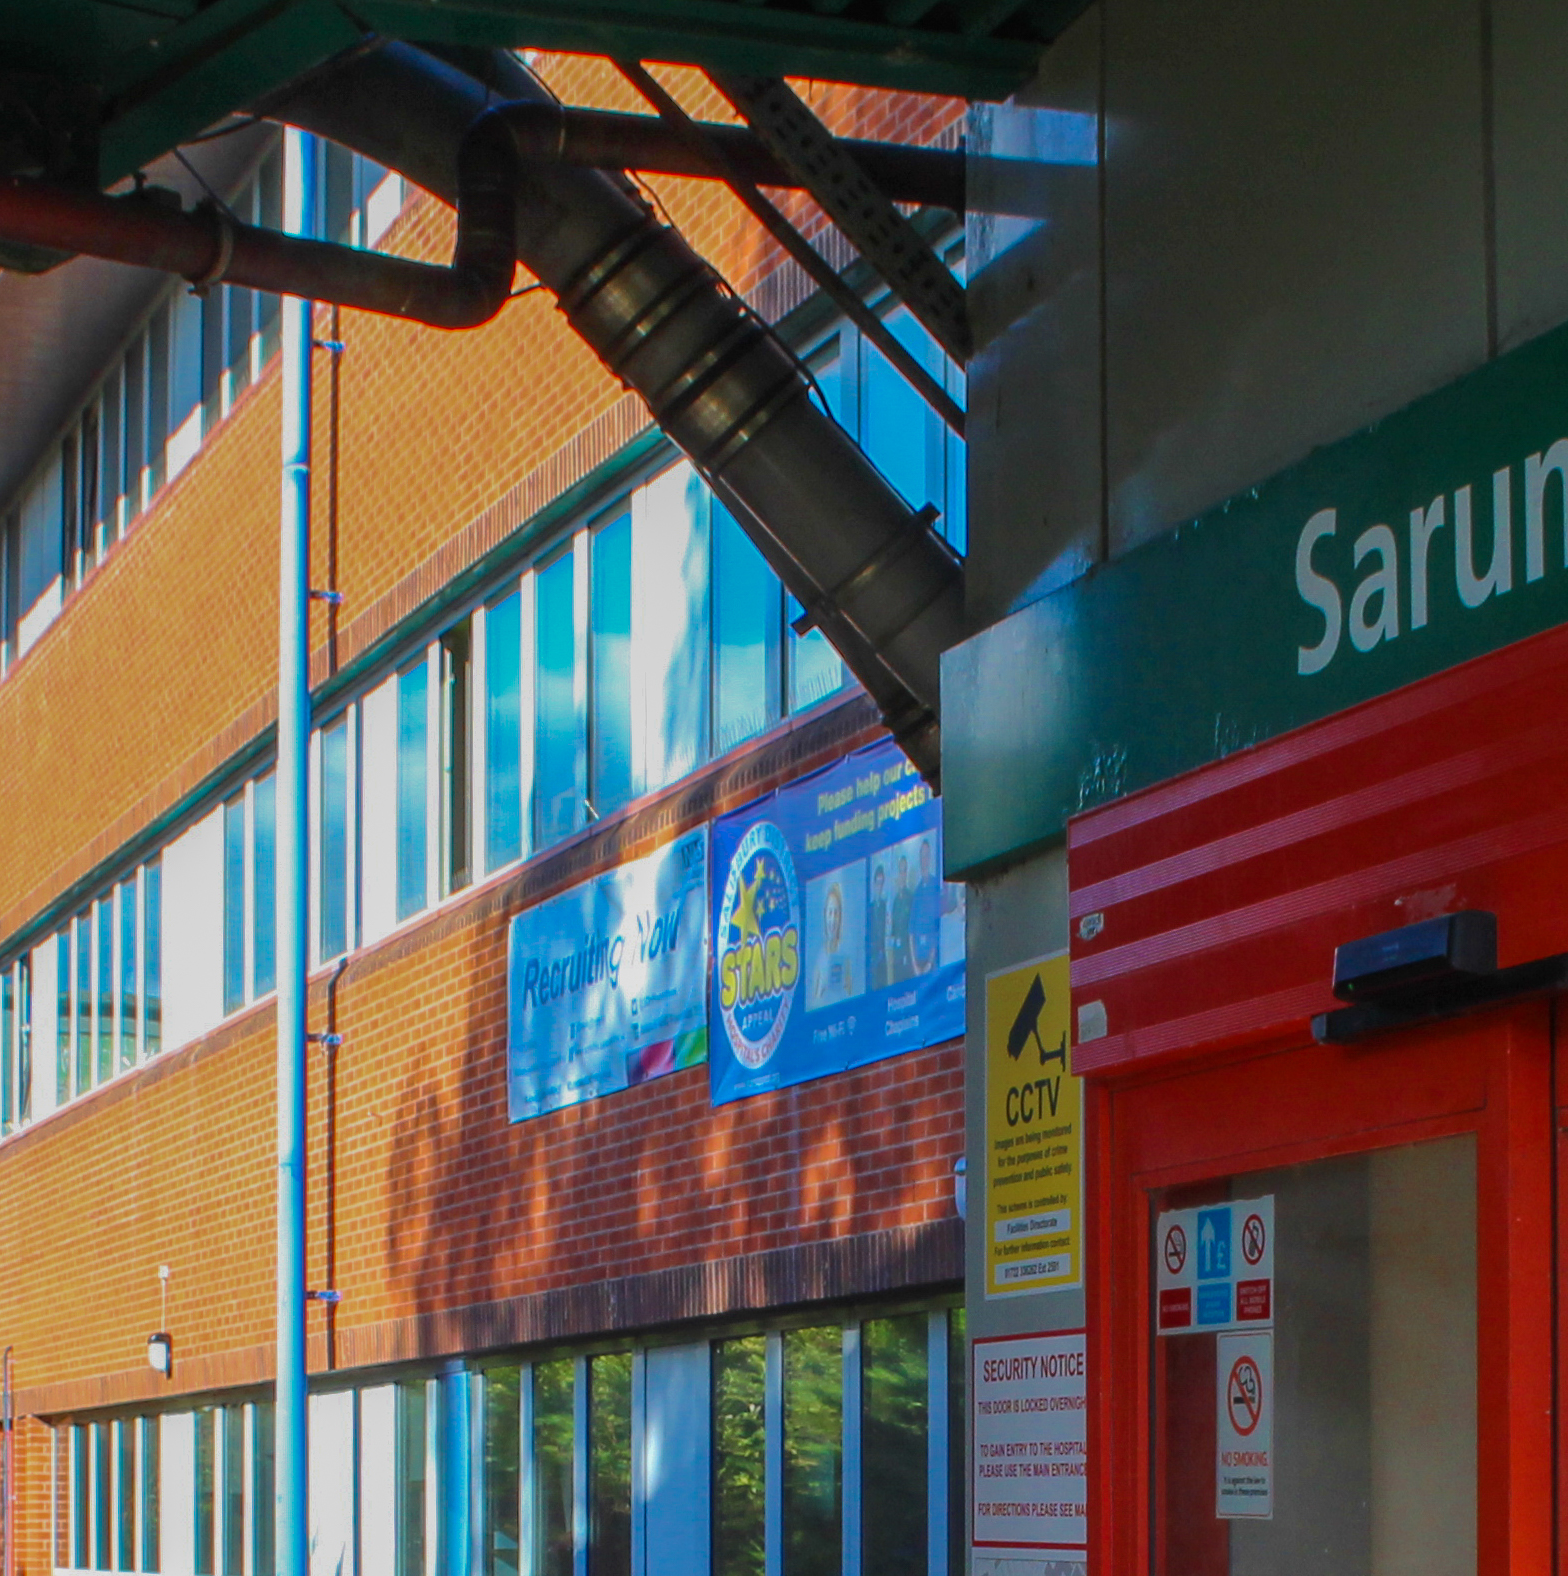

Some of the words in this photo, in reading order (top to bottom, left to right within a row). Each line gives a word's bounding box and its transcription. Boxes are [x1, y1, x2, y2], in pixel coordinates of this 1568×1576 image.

[818, 786, 853, 816] Please
[856, 771, 880, 798] help
[884, 762, 902, 786] our
[805, 829, 831, 853] keep
[834, 810, 874, 841] funding
[878, 784, 926, 828] projects
[523, 928, 625, 1011] Recruiting
[631, 906, 681, 964] Now
[721, 928, 799, 1010] STARS
[742, 1008, 774, 1031] APPEAL
[1006, 1075, 1061, 1128] CCTV
[983, 1355, 1038, 1383] SECURITY
[1041, 1352, 1084, 1379] NOTICE
[978, 1401, 991, 1415] THIS
[993, 1400, 1012, 1414] DOOR
[1013, 1399, 1019, 1413] IS
[1021, 1398, 1049, 1413] LOCKED
[1050, 1396, 1086, 1411] OVERNIGH
[980, 1444, 989, 1457] TO
[990, 1443, 1005, 1457] GAIN
[1006, 1442, 1028, 1456] ENTRY
[1029, 1442, 1038, 1456] TO
[1039, 1442, 1053, 1456] THE
[1233, 1451, 1268, 1467] SMOKING
[978, 1463, 1003, 1478] PLEASE
[1004, 1463, 1018, 1478] USE
[1019, 1463, 1032, 1477] THE
[1033, 1462, 1051, 1477] MAIN
[1051, 1462, 1087, 1477] ENTRANC
[978, 1503, 991, 1517] FOR
[992, 1503, 1031, 1517] DIRECTIONS
[1032, 1503, 1058, 1518] PLEASE
[1059, 1503, 1073, 1517] SEE
[1074, 1503, 1086, 1518] MA
